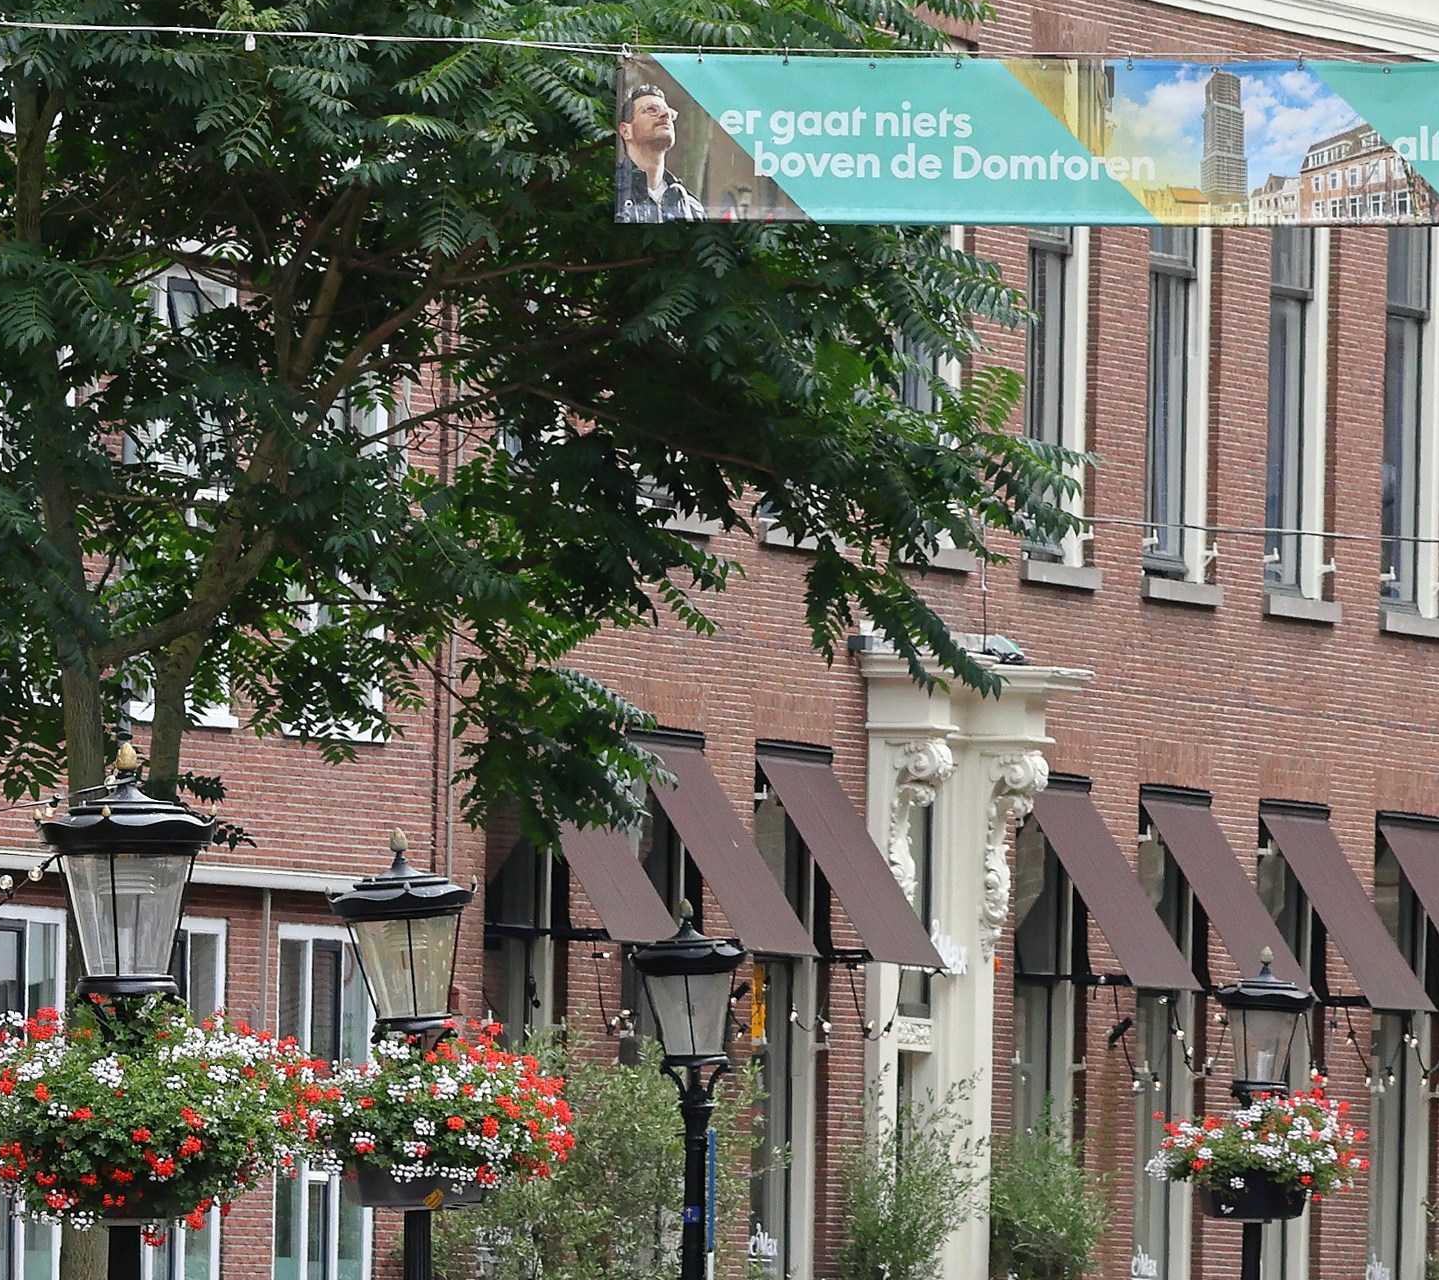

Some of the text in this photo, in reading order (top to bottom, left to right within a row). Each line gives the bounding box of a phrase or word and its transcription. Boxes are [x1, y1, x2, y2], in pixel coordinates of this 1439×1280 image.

[719, 100, 973, 144] er gaat niets
[754, 142, 1156, 181] boven de Domtoren
